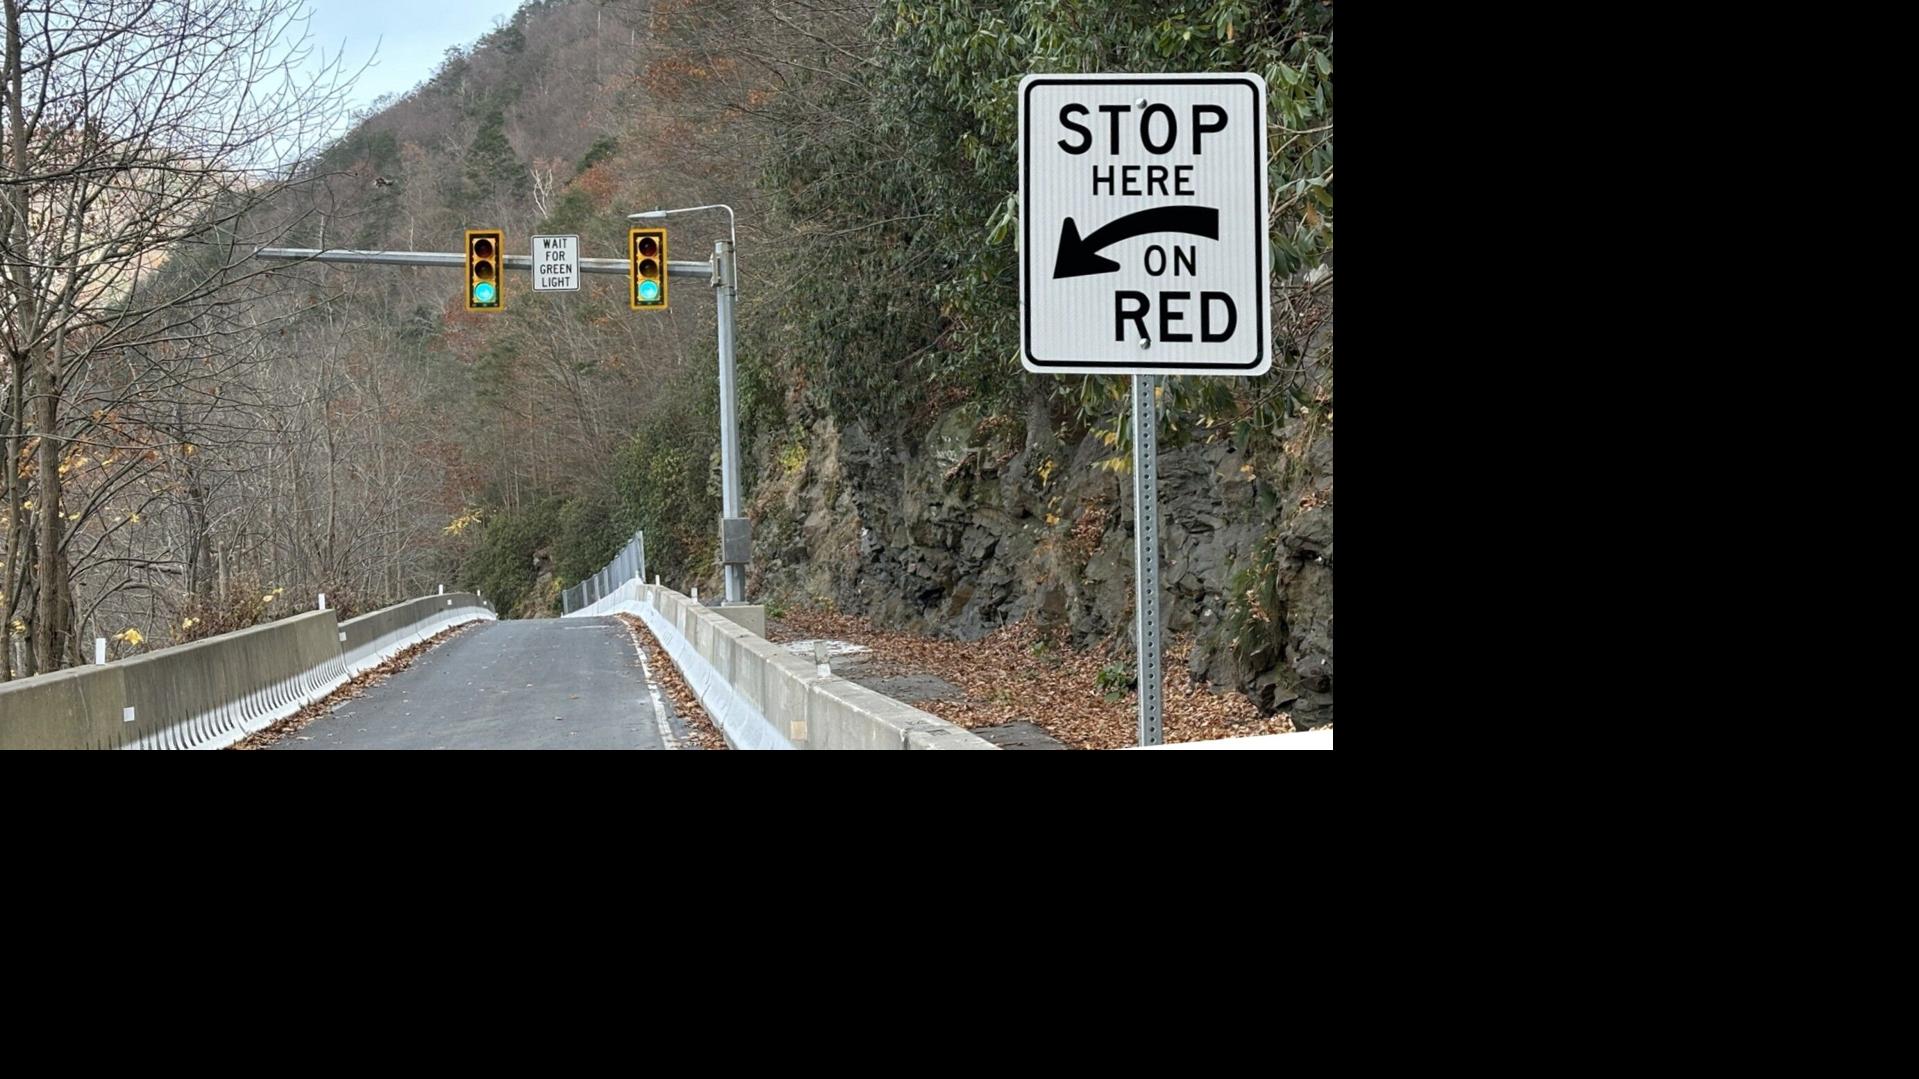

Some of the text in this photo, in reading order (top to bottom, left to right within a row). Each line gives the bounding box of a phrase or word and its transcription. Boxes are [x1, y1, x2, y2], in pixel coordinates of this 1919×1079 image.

[1057, 103, 1228, 155] STOP
[1092, 165, 1195, 196] HERE
[543, 238, 567, 249] WAIT
[545, 250, 566, 261] FOR
[1144, 245, 1197, 277] ON
[540, 264, 572, 274] GREEN
[541, 277, 570, 287] LIGHT
[1115, 290, 1238, 343] RED
